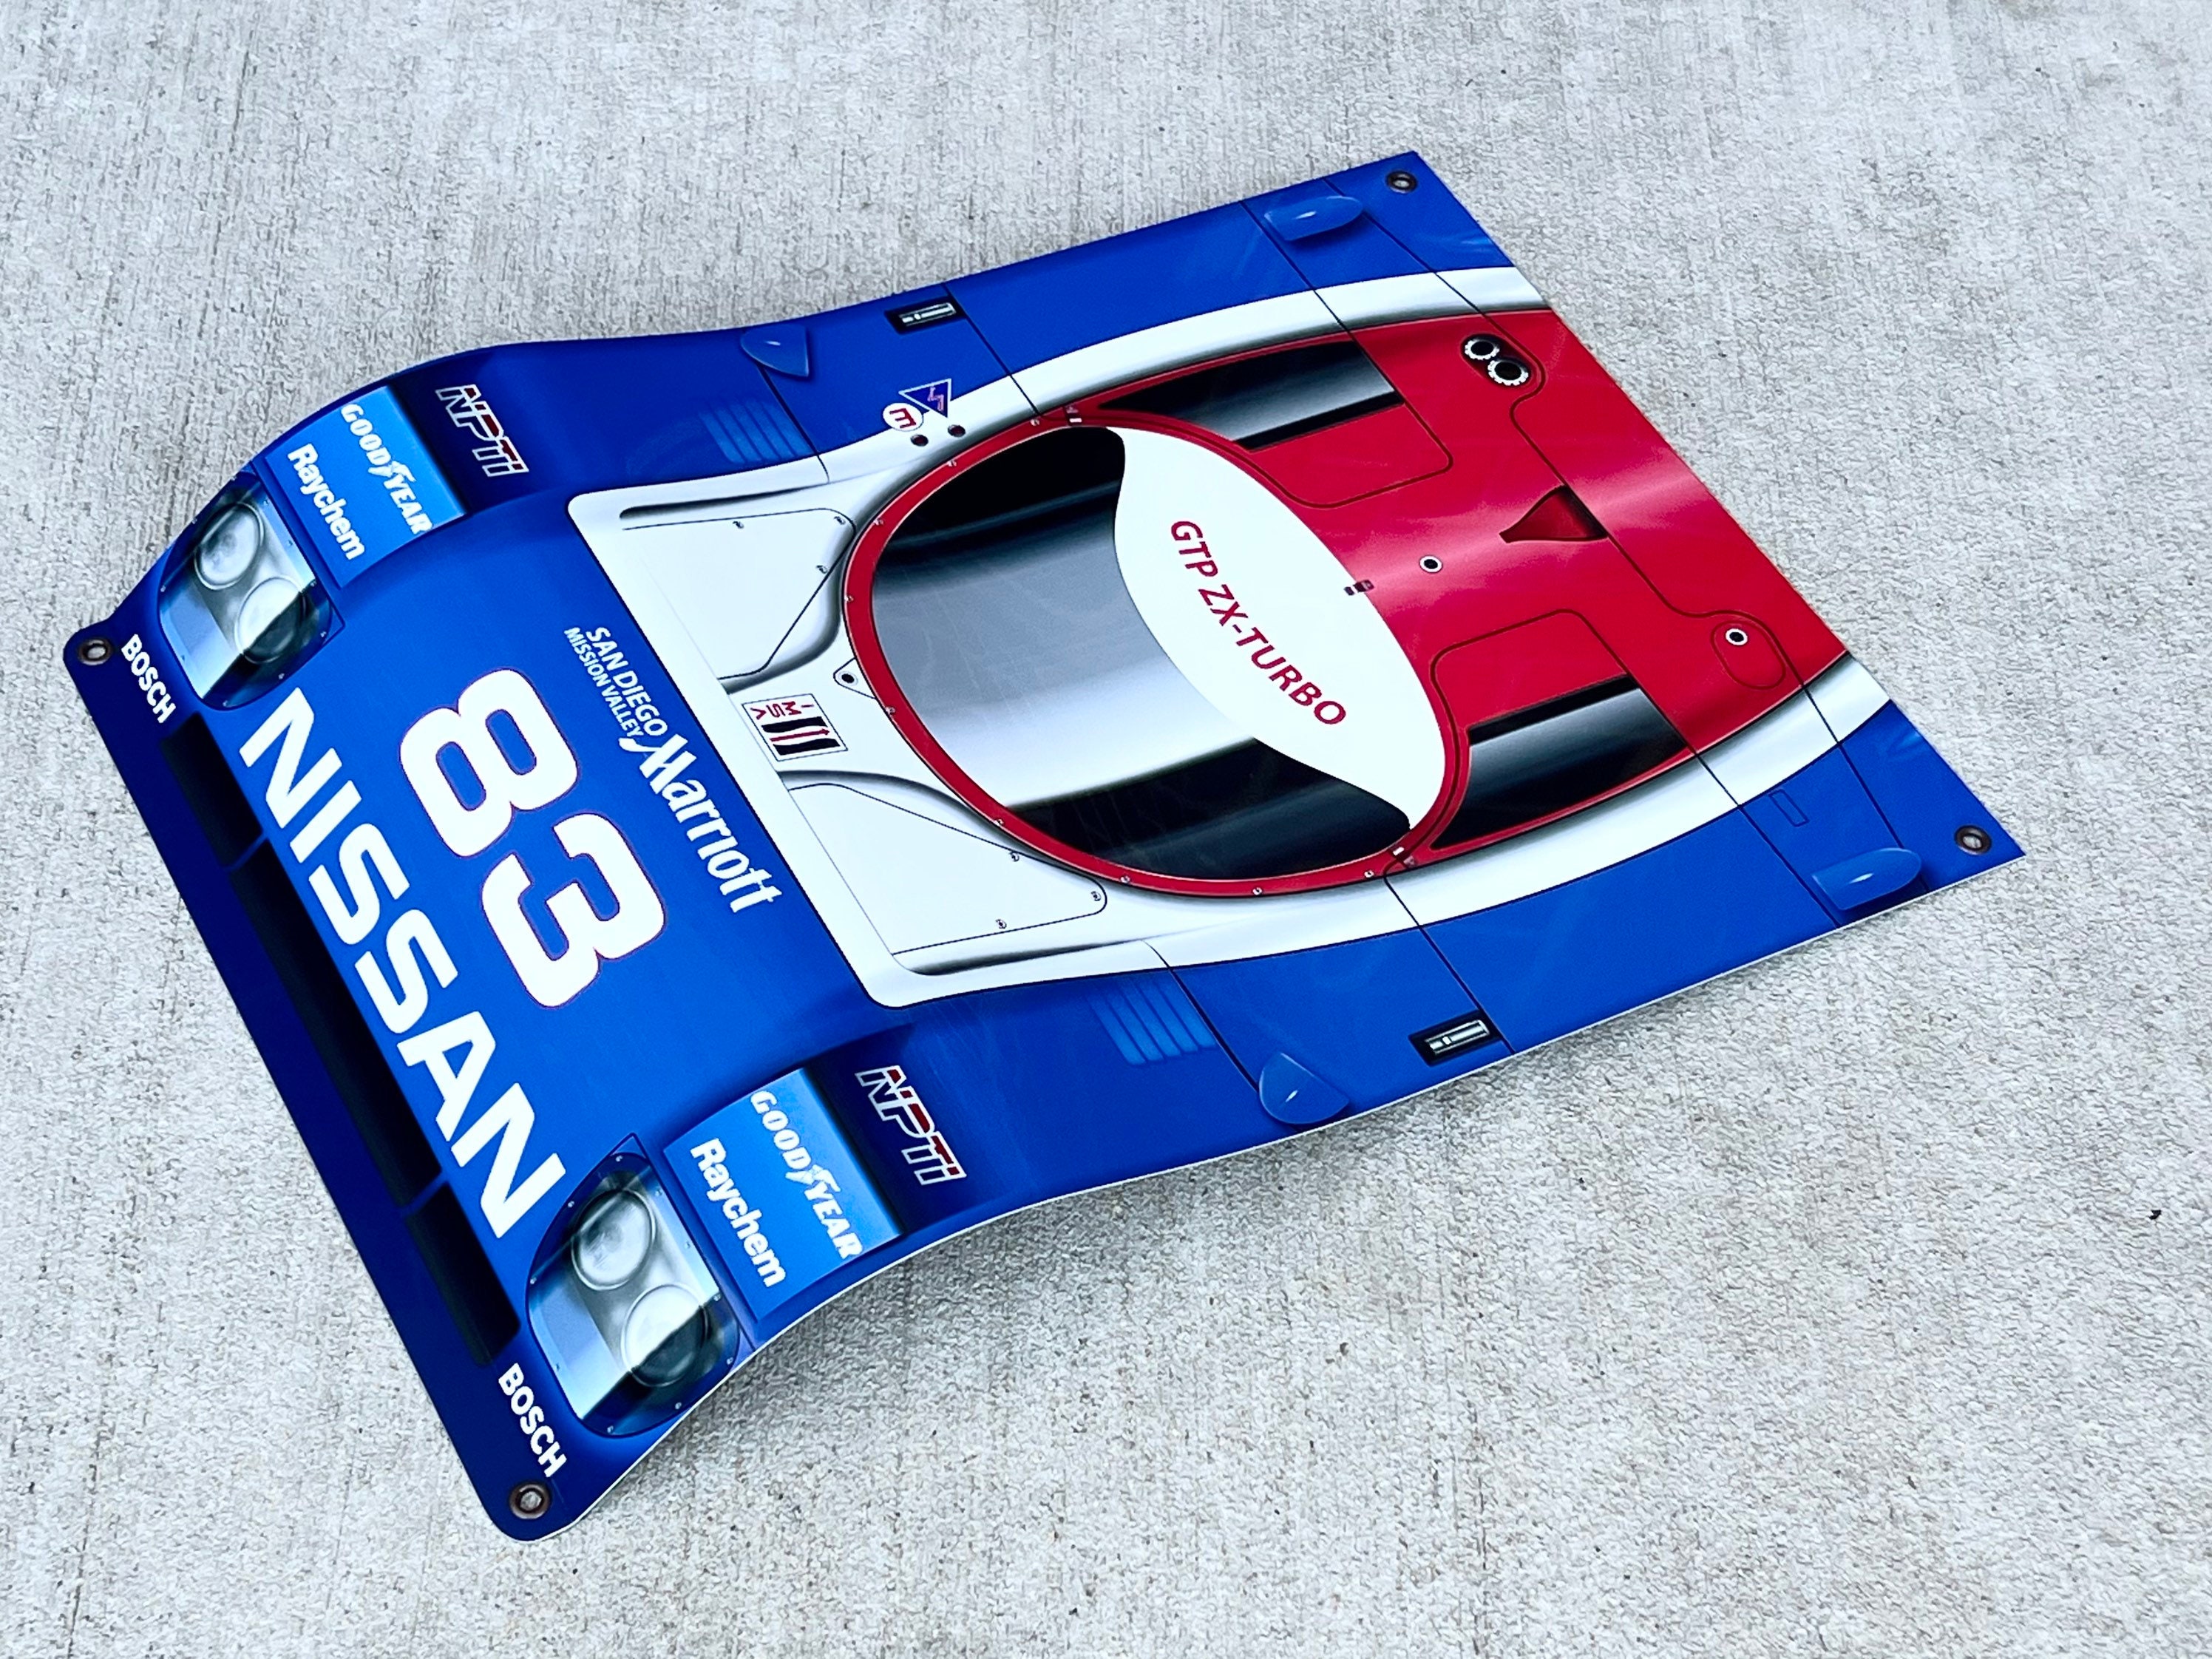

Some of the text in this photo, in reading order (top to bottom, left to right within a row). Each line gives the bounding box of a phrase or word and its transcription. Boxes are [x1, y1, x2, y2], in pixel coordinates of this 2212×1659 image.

[287, 443, 365, 560] Raychem
[121, 634, 177, 724] BOSCH
[563, 627, 646, 738] MISSION VALLEY
[588, 626, 668, 737] SAN DIEGO
[1170, 520, 1347, 725] GTP ZX-TURBO
[399, 668, 666, 1008] 83
[618, 733, 783, 913] Marriott
[239, 687, 566, 1239] NISSAN
[690, 1138, 787, 1288] Raychem
[498, 1363, 567, 1478] BOSCH
